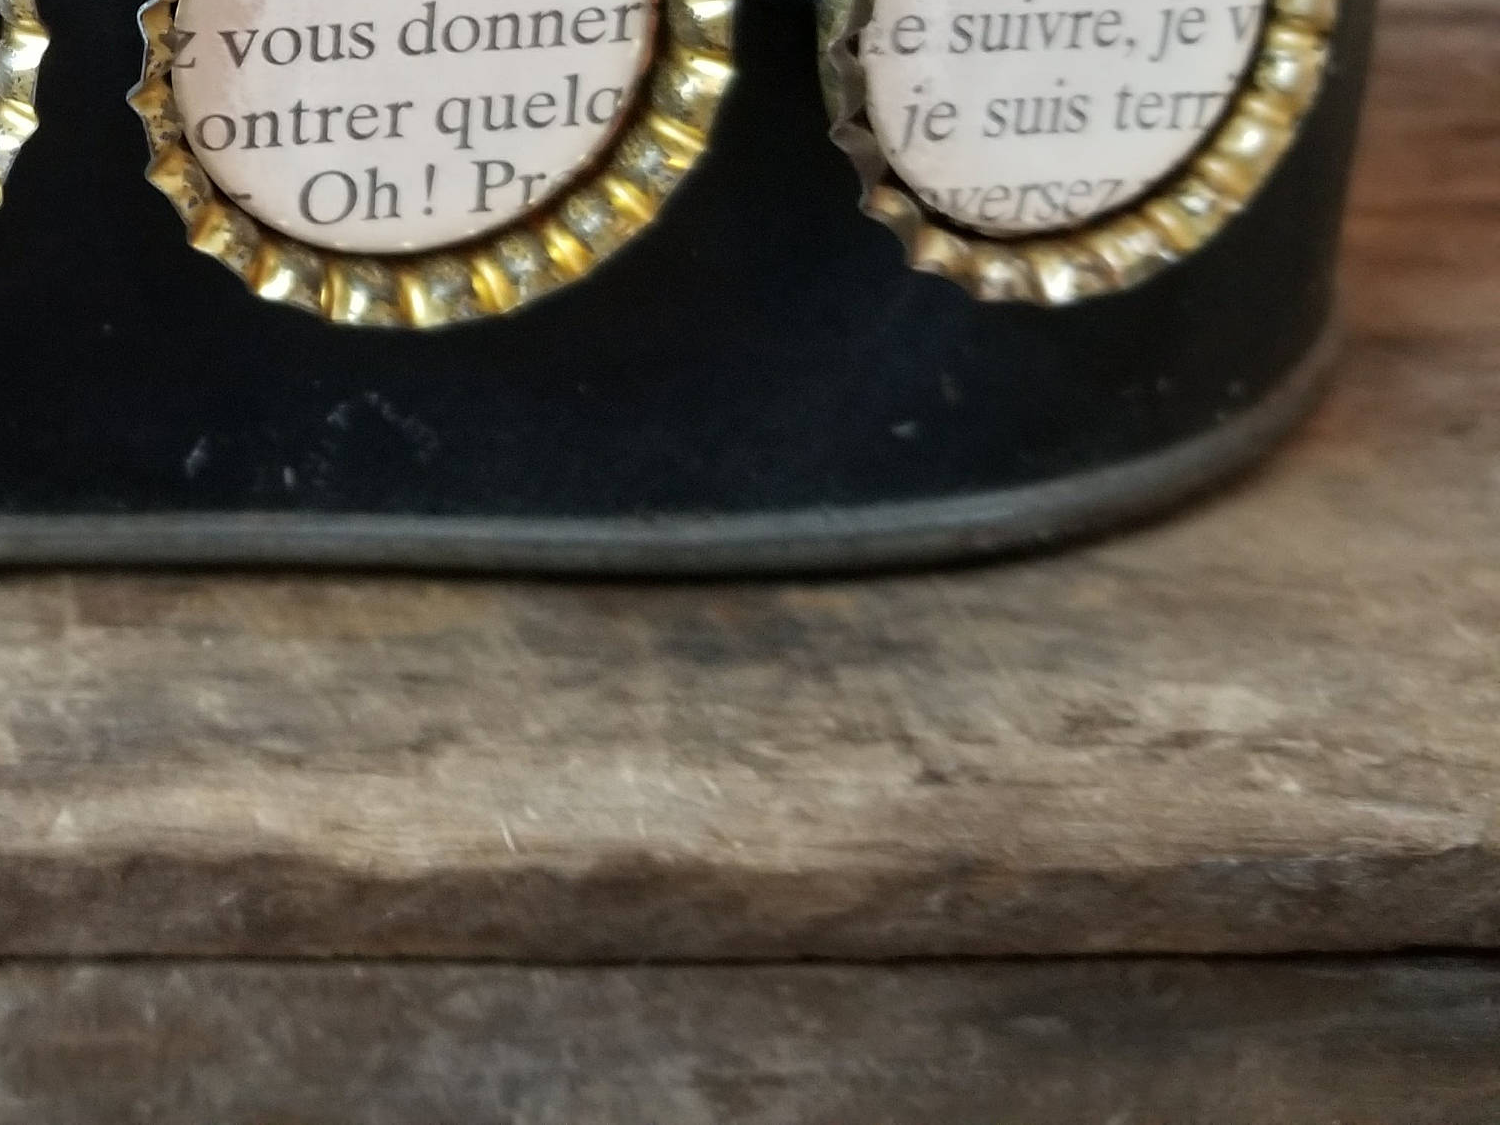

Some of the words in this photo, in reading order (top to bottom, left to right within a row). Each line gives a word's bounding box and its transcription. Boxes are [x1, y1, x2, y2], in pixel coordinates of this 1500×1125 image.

[218, 20, 376, 68] vous
[398, 1, 645, 56] donner
[195, 96, 413, 153] ontrer
[899, 85, 958, 152] je
[982, 78, 1092, 139] suis
